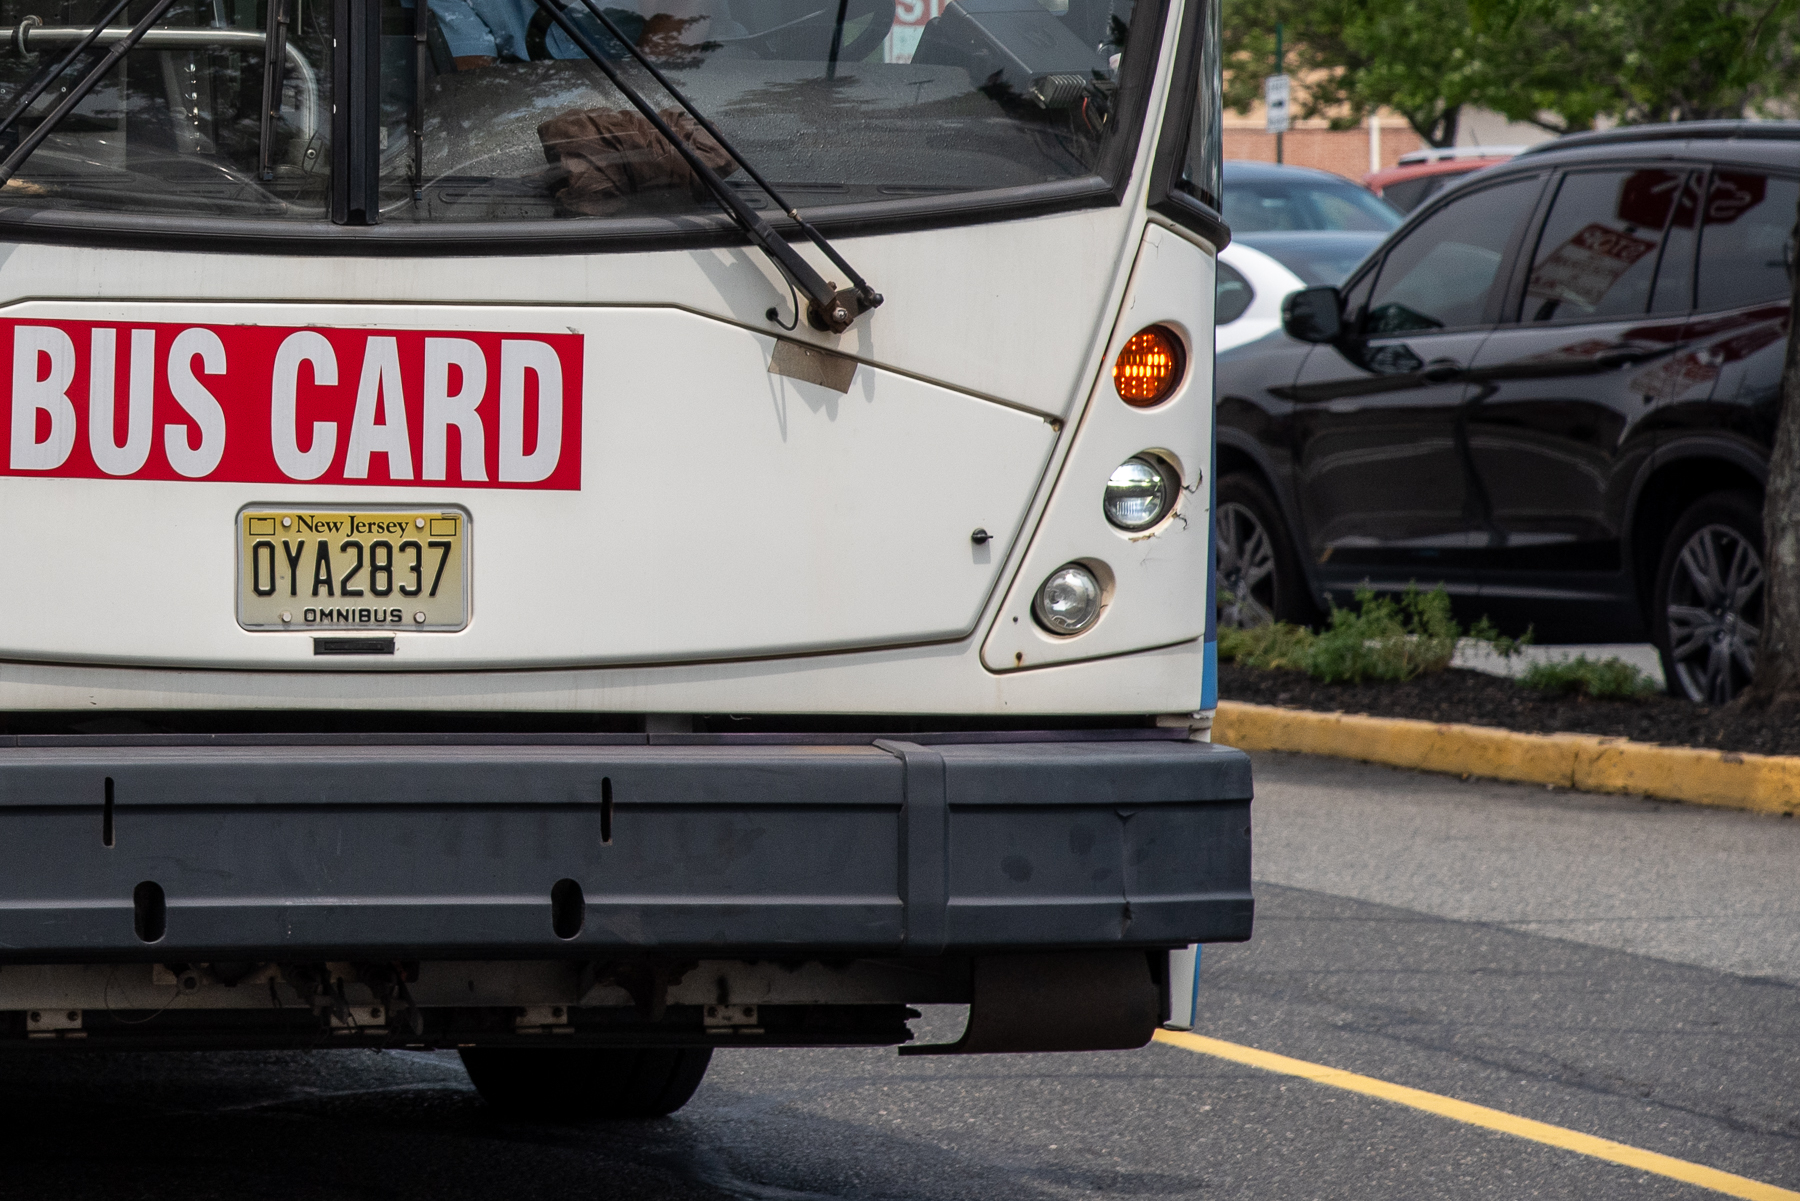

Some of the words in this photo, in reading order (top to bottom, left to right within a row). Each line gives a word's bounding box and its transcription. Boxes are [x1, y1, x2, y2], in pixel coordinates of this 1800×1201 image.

[10, 327, 226, 478] BUS
[272, 331, 564, 483] CARD
[296, 515, 344, 533] New
[347, 515, 409, 538] Jersey
[303, 608, 403, 623] OMNIBUS
